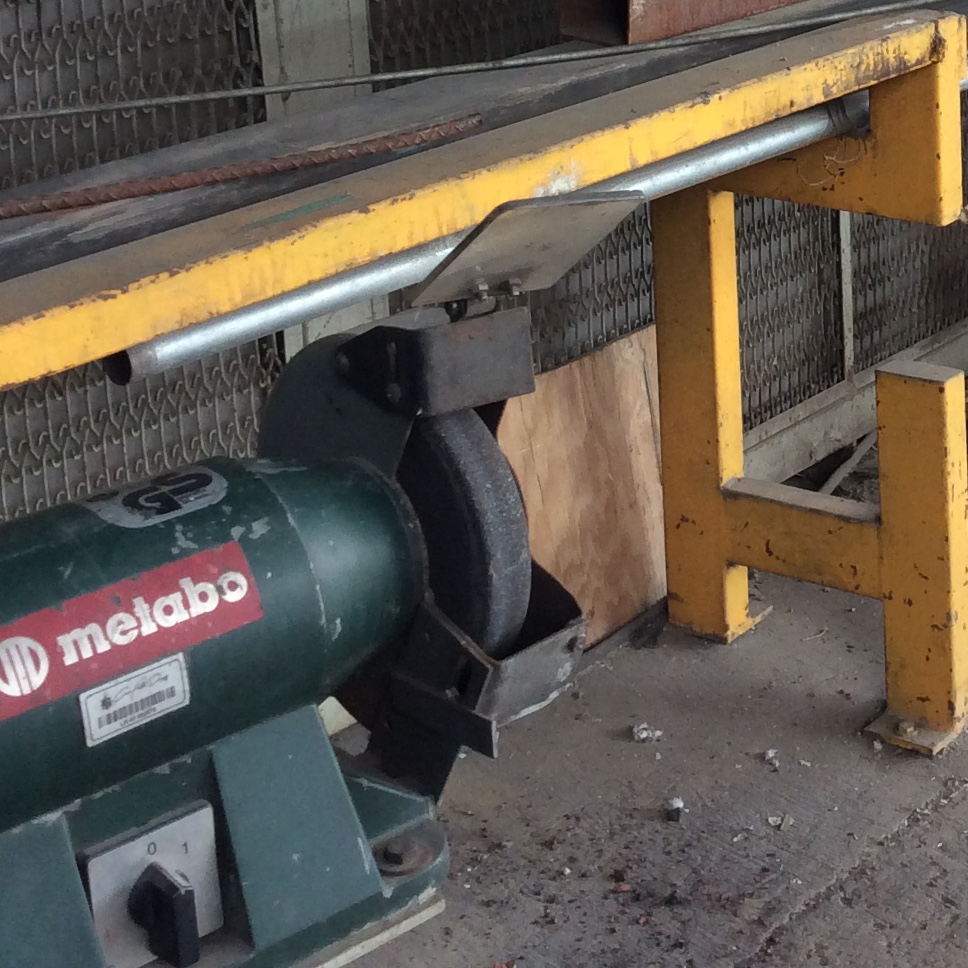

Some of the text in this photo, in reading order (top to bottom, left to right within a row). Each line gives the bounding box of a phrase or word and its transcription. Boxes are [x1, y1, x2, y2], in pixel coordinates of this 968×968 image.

[56, 571, 249, 666] metabo
[146, 840, 189, 856] 0 1
